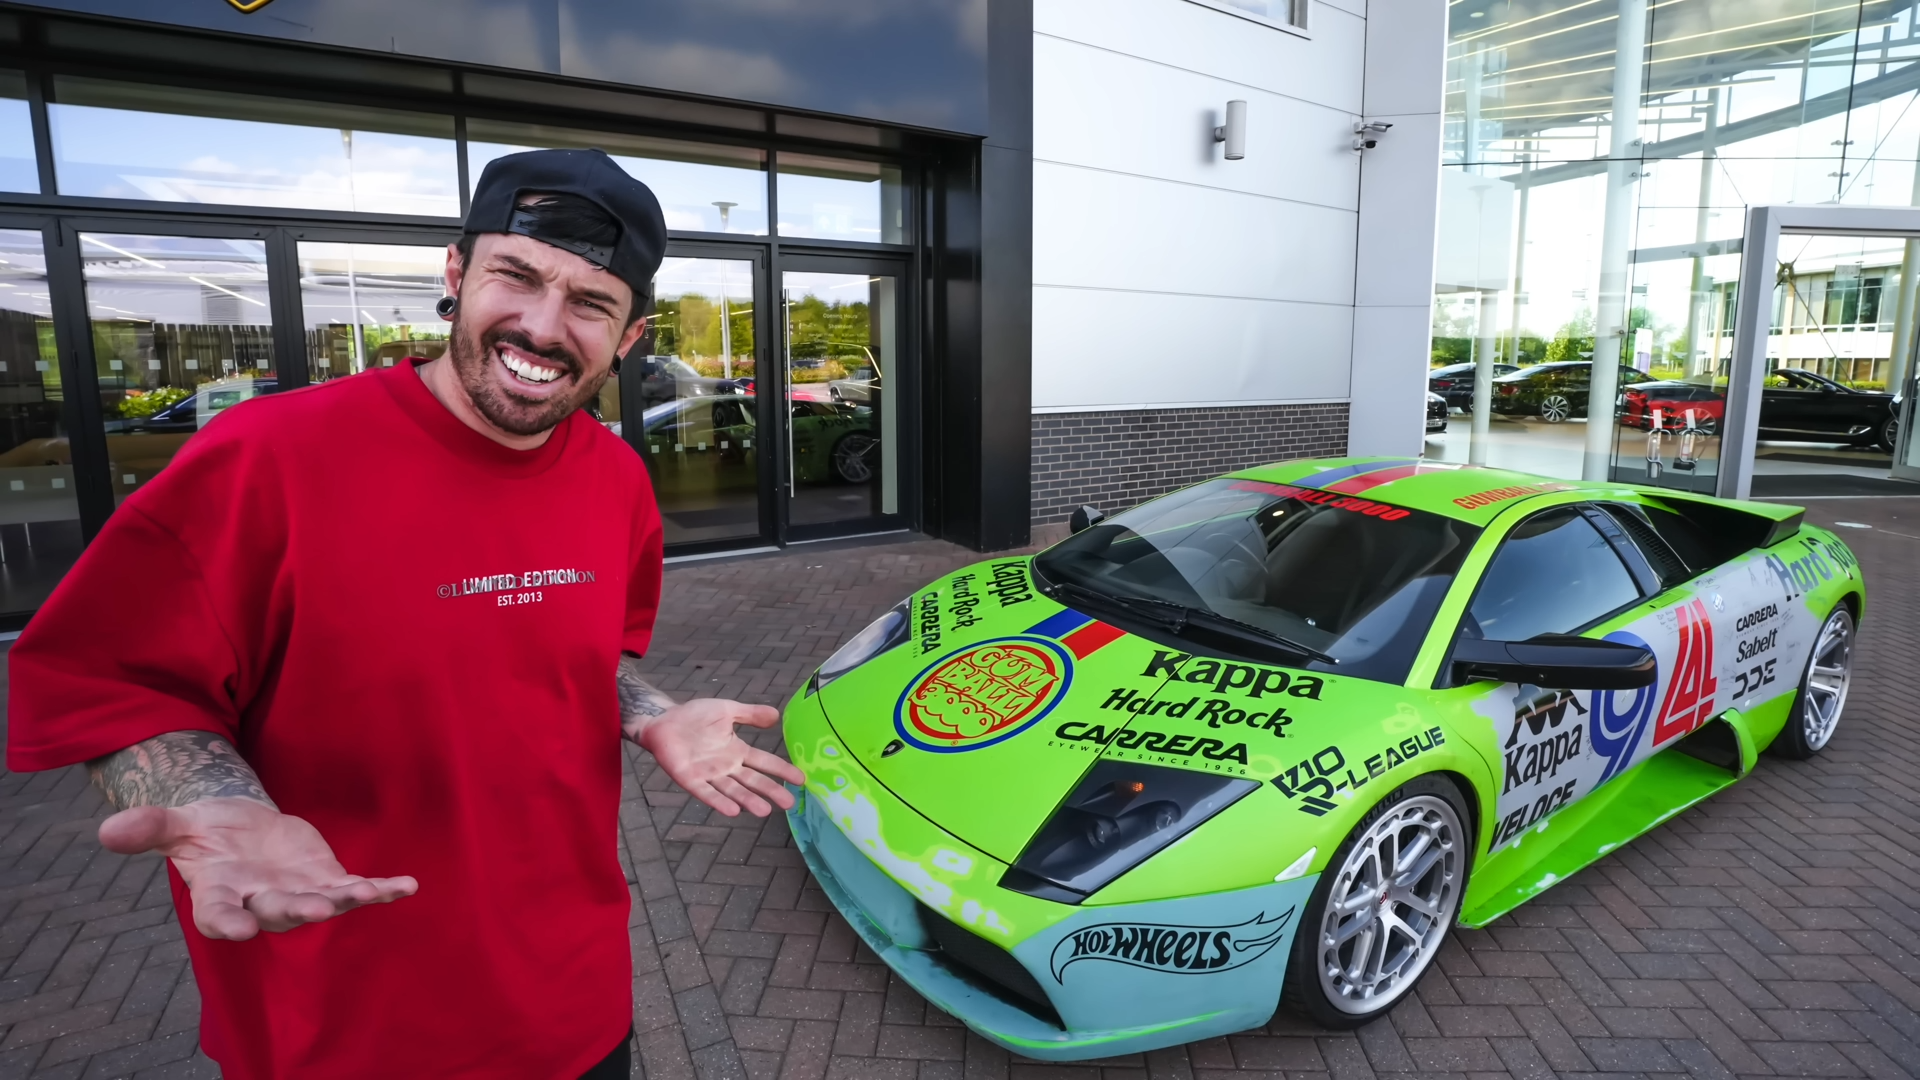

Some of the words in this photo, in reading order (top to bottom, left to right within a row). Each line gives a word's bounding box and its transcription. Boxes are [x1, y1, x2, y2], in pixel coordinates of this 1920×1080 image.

[1329, 497, 1411, 521] 3000
[1452, 485, 1544, 510] GUMBALL
[523, 568, 577, 587] EDITION
[951, 573, 979, 600] Hard
[986, 560, 1034, 608] Kappa
[1764, 539, 1834, 602] Hard
[497, 594, 516, 606] EST.
[517, 591, 543, 604] 2013
[948, 597, 983, 632] Rock
[1735, 603, 1779, 632] CARRERA
[920, 591, 942, 655] CARRERA
[1735, 627, 1779, 664] Sabelt
[936, 659, 1037, 722] BALL
[969, 645, 1060, 698] GUM
[1139, 649, 1325, 702] Kappa
[907, 682, 995, 738] 3000
[1099, 688, 1201, 720] Hard
[1194, 698, 1293, 738] Rock
[1048, 741, 1124, 758] EYEWEAR
[1137, 753, 1189, 766] SINCE
[1204, 762, 1247, 775] 1956
[1055, 721, 1249, 766] CARRERA
[1502, 723, 1583, 797] Kappa
[1487, 778, 1578, 855] VELOCE
